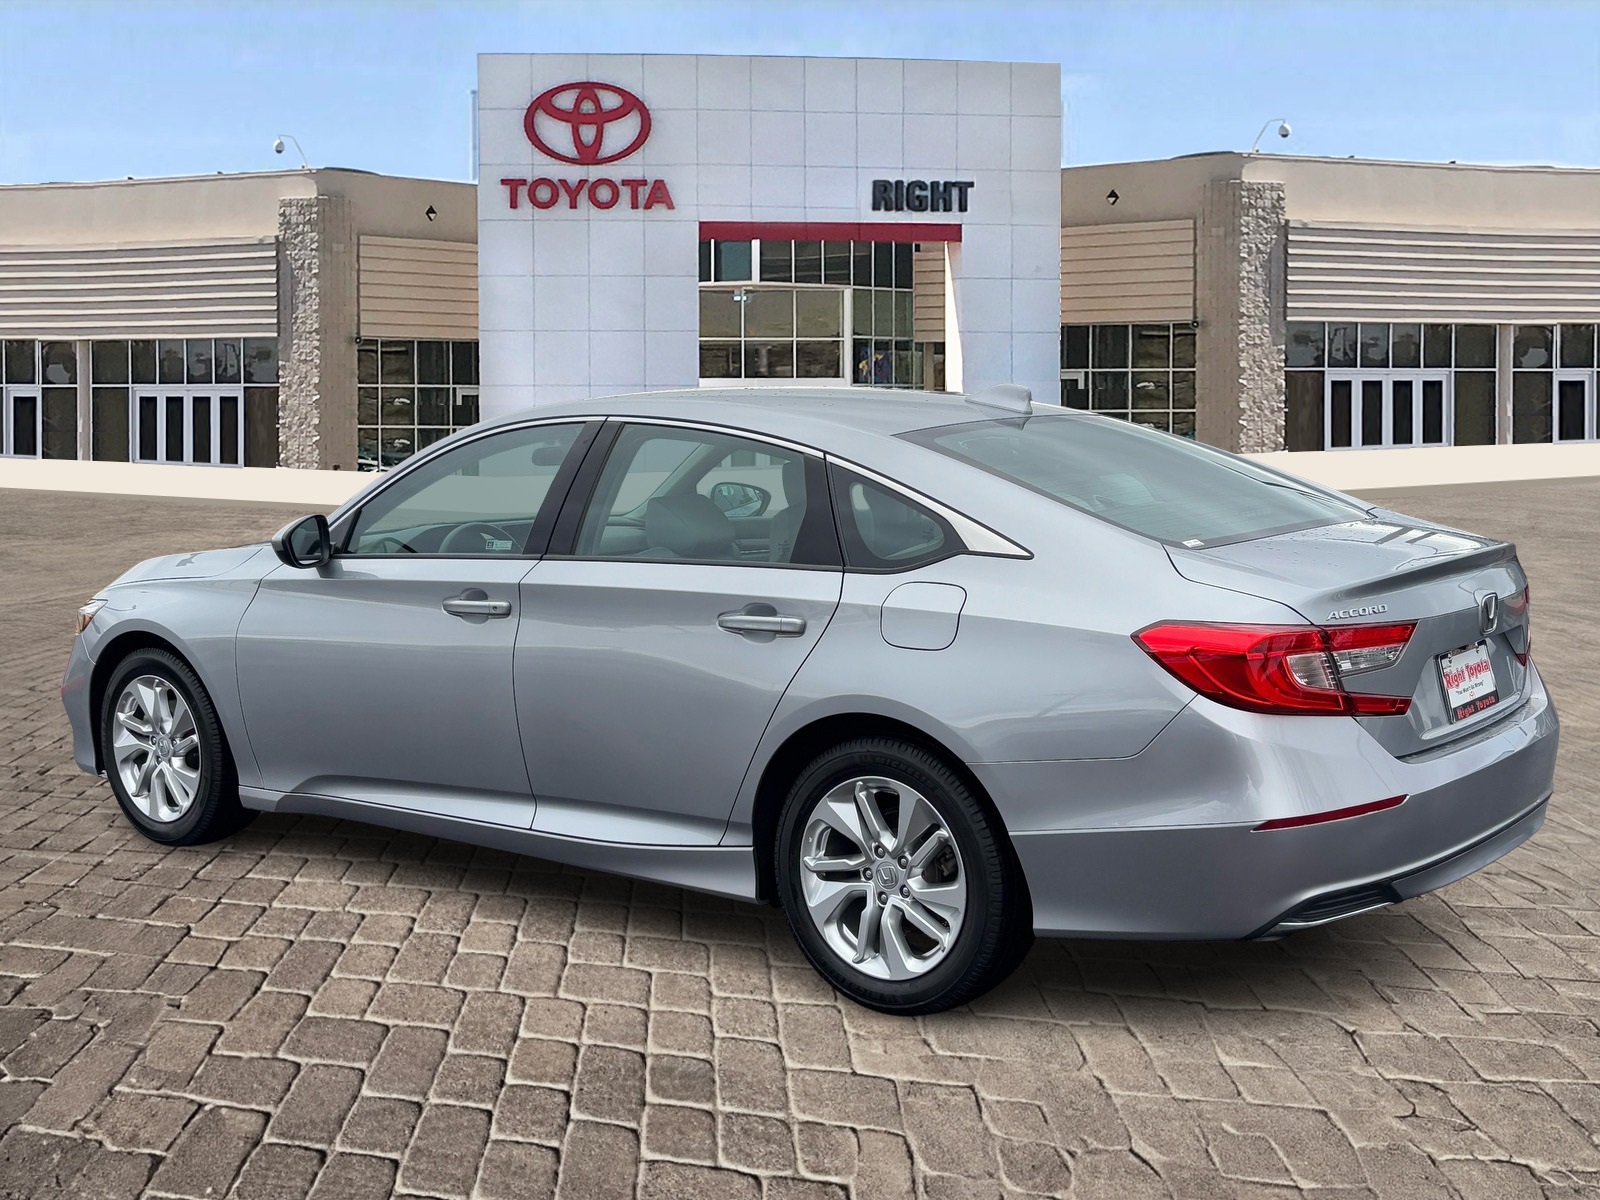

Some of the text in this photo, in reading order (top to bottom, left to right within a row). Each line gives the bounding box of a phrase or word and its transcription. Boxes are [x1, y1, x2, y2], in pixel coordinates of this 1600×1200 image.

[501, 178, 675, 210] TOYOTA
[871, 179, 975, 213] RIGHT
[1326, 604, 1388, 621] ACCORD
[1444, 658, 1490, 689] Right Toyota
[1457, 696, 1496, 719] Right Toyota
